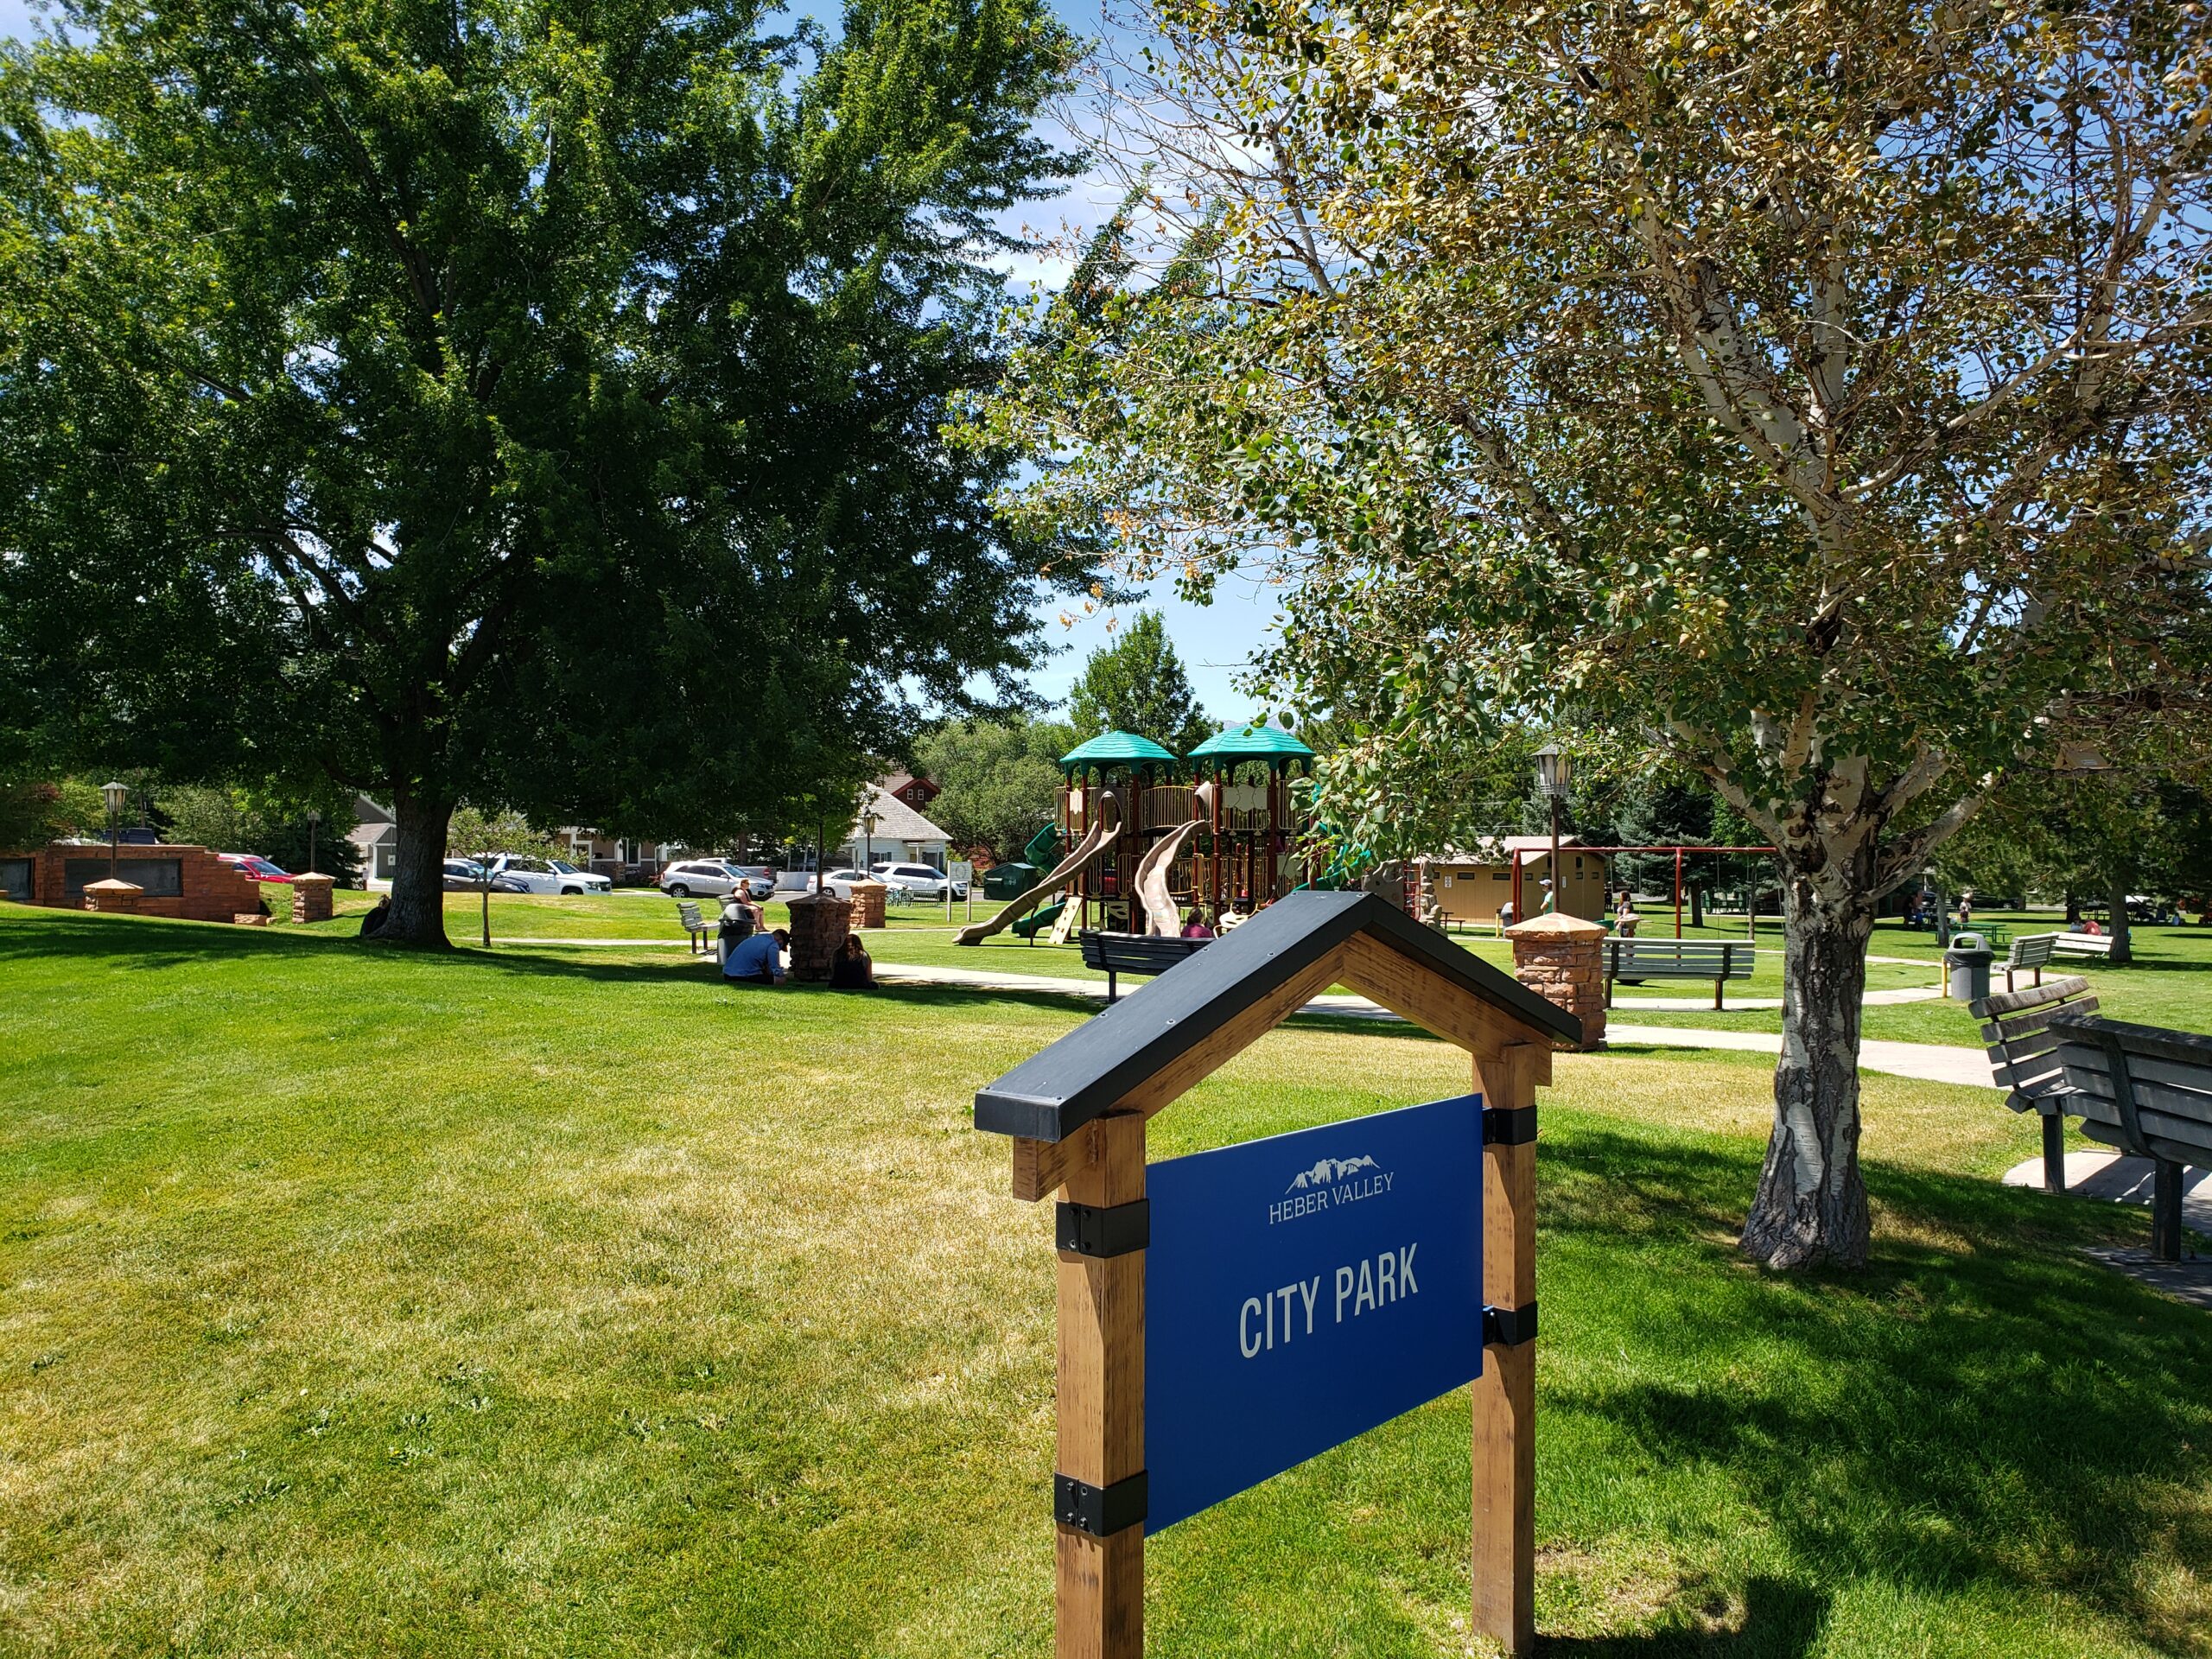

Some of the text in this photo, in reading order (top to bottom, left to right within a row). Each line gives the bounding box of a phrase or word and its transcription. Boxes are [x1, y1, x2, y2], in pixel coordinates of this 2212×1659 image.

[1268, 1172, 1395, 1224] HEBER VALLEY
[1239, 1243, 1419, 1358] CITY PARK
